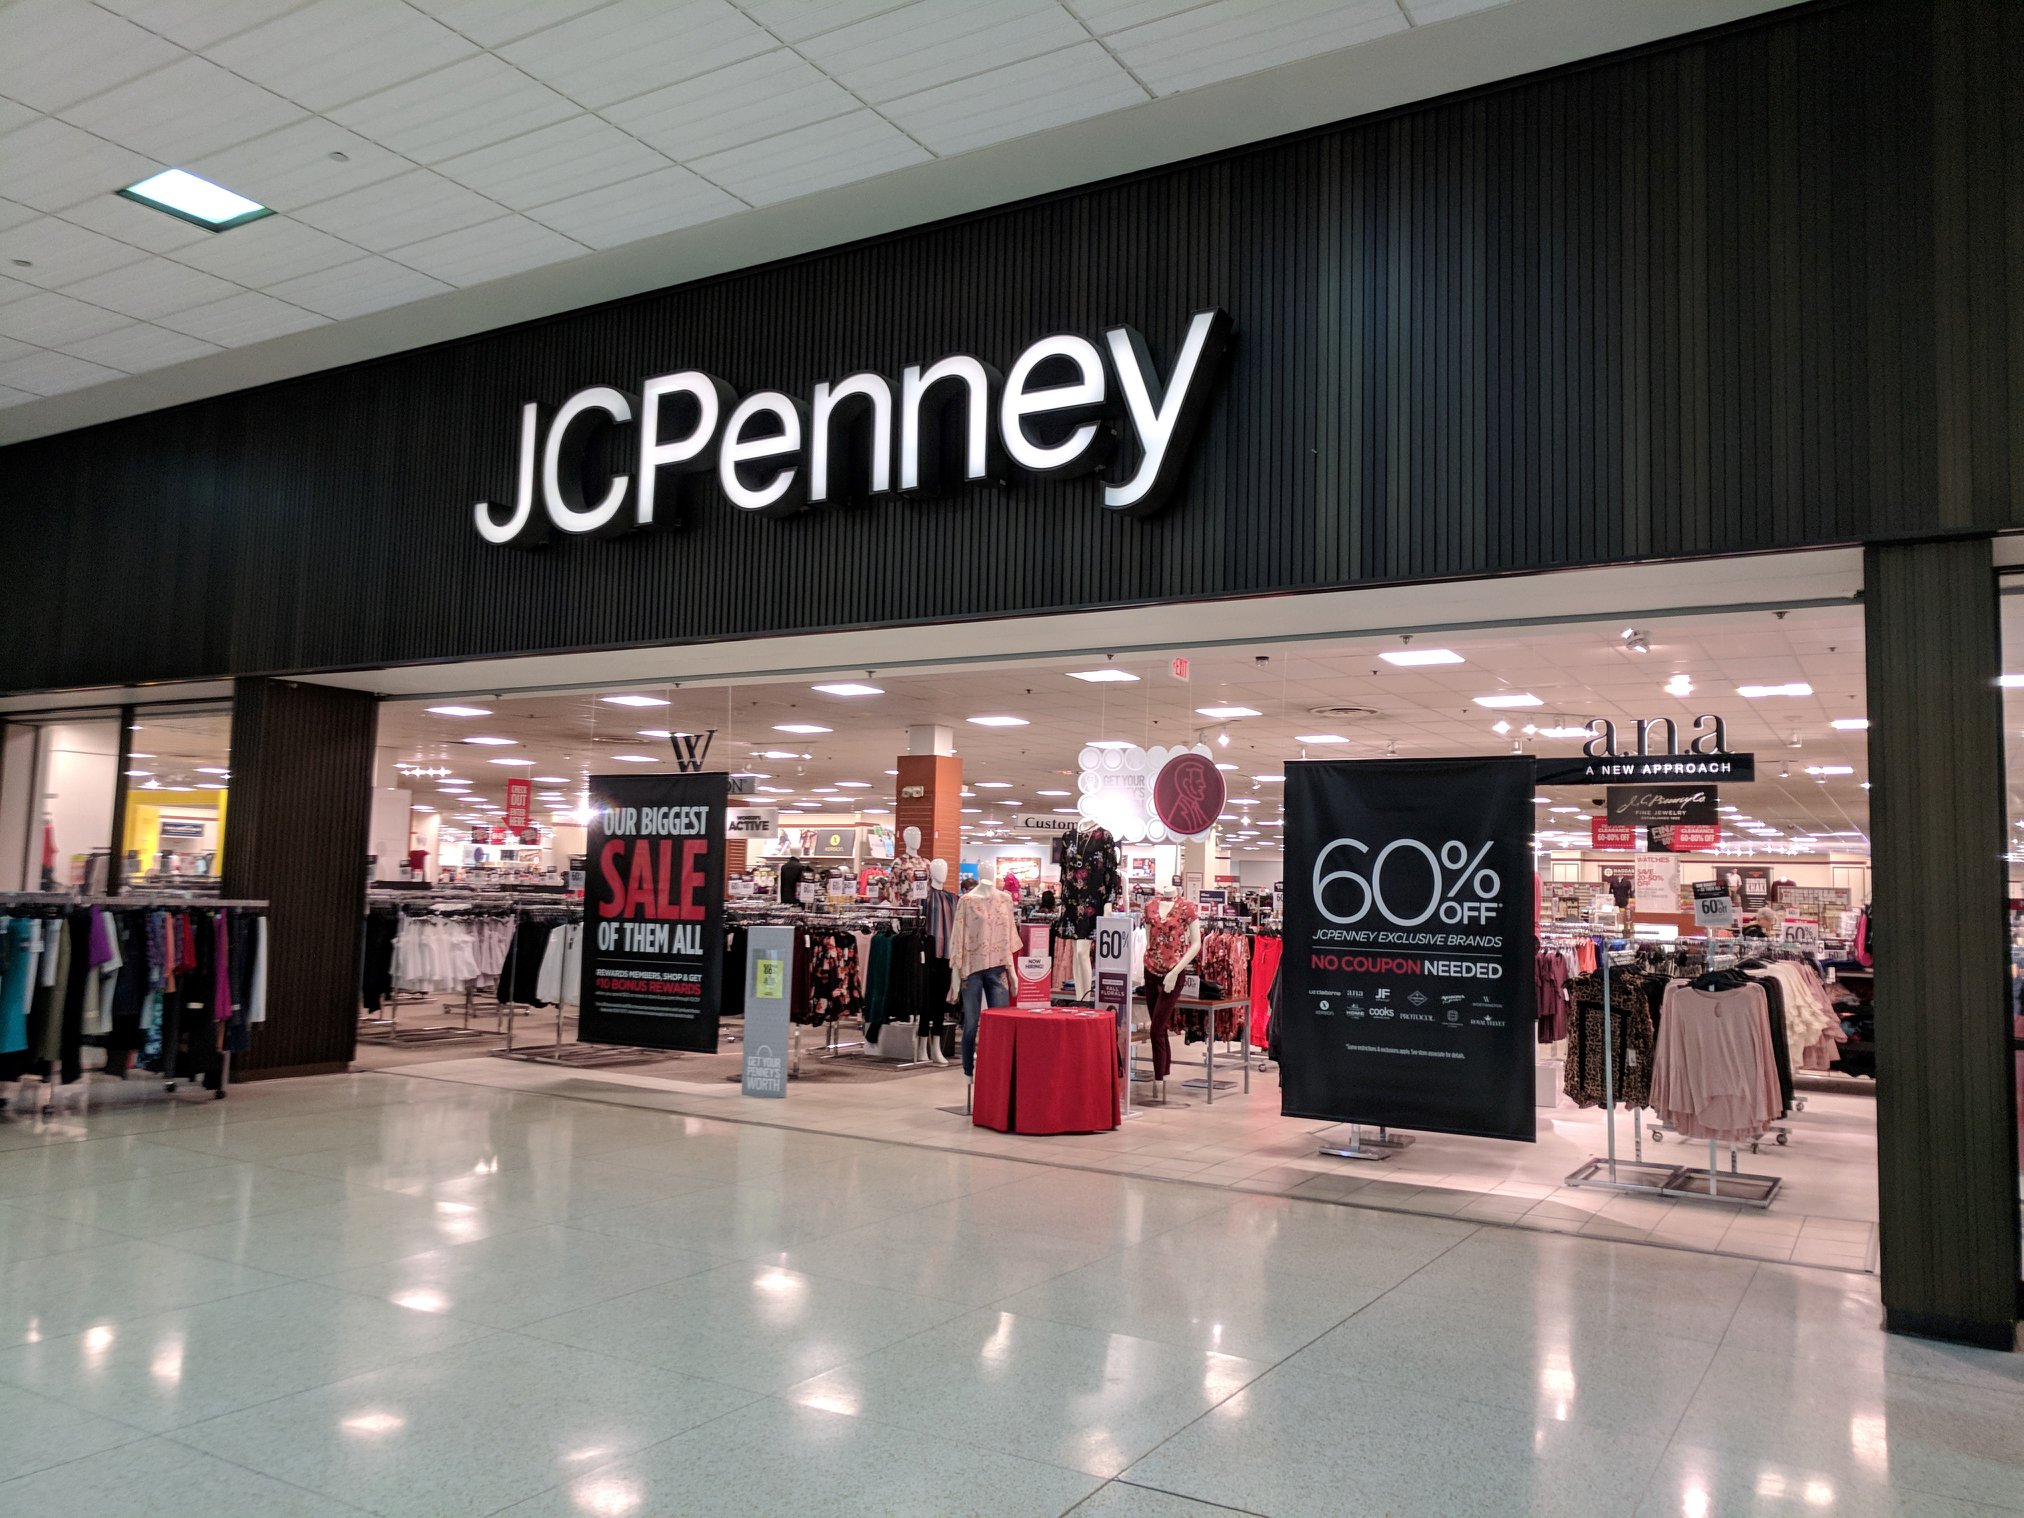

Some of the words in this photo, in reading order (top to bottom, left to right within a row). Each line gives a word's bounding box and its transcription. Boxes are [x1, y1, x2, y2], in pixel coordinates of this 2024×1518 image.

[472, 308, 1218, 545] JCPenney
[669, 729, 718, 772] W
[1585, 766, 1594, 775] A
[1602, 764, 1635, 775] NEW
[1642, 762, 1731, 775] APPROACH
[1122, 775, 1145, 786] YOUR
[510, 794, 526, 806] OUT
[603, 807, 637, 836] OUR
[640, 806, 709, 835] BIGGEST
[729, 820, 770, 831] ACTIVE
[1024, 817, 1078, 830] Custom
[598, 839, 708, 920] SALE
[1312, 837, 1501, 927] 60%
[597, 922, 620, 951] OF
[623, 922, 669, 954] THEM
[671, 924, 704, 955] ALL
[1312, 929, 1377, 942] JCPENNEY
[1378, 932, 1446, 945] EXCLUSIVE
[1447, 935, 1503, 947] BRANDS
[1311, 954, 1338, 970] NO
[1341, 956, 1421, 975] COUPON
[1424, 960, 1503, 979] NEEDED
[595, 968, 629, 979] REWARDS
[662, 972, 682, 981] SHOP
[689, 974, 702, 982] GET
[611, 979, 647, 991] BONUS
[649, 981, 701, 995] REWARDS
[1375, 988, 1391, 999] JF
[1369, 1007, 1395, 1017] cooks
[748, 1056, 761, 1067] GET
[762, 1057, 781, 1068] YOUR
[747, 1078, 780, 1092] WORTH
